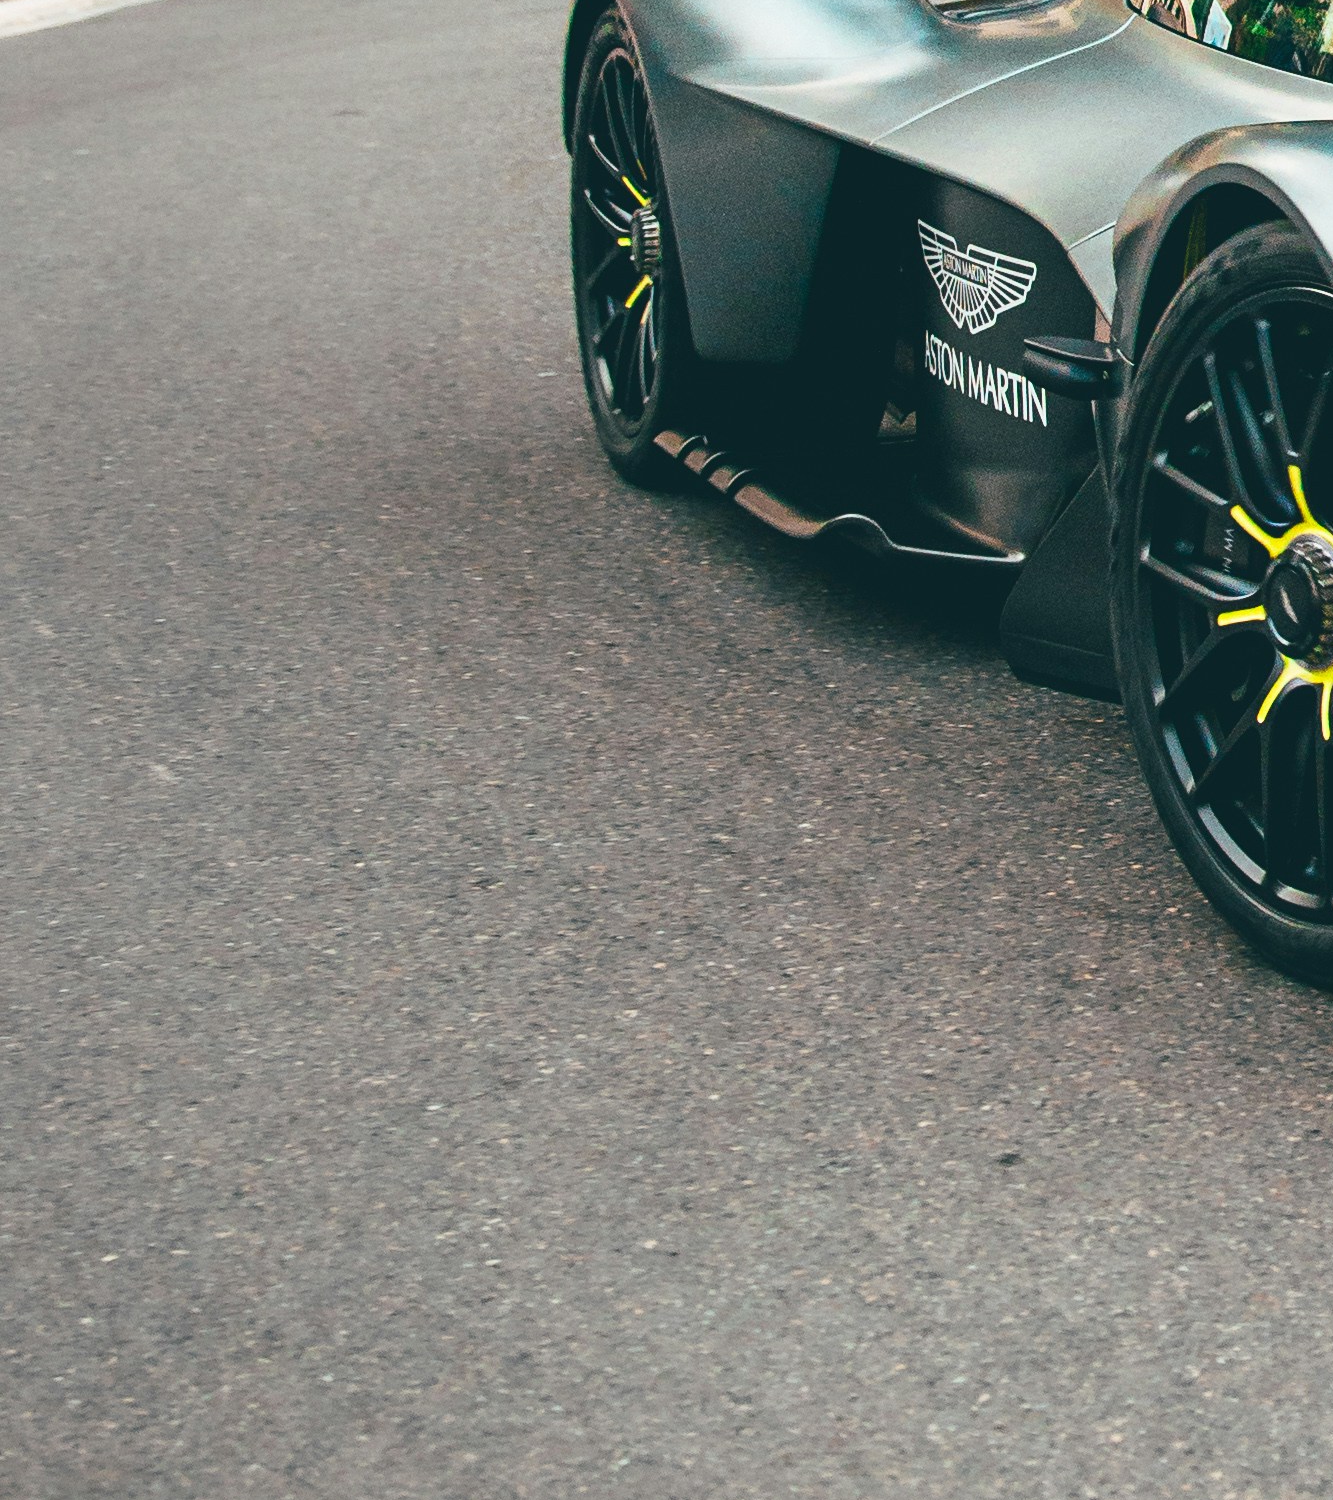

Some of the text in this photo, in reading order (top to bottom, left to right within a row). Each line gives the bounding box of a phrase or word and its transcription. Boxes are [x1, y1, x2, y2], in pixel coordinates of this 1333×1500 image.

[943, 252, 988, 285] ASTON MARTIN
[924, 329, 1048, 428] ASTON MARTIN
